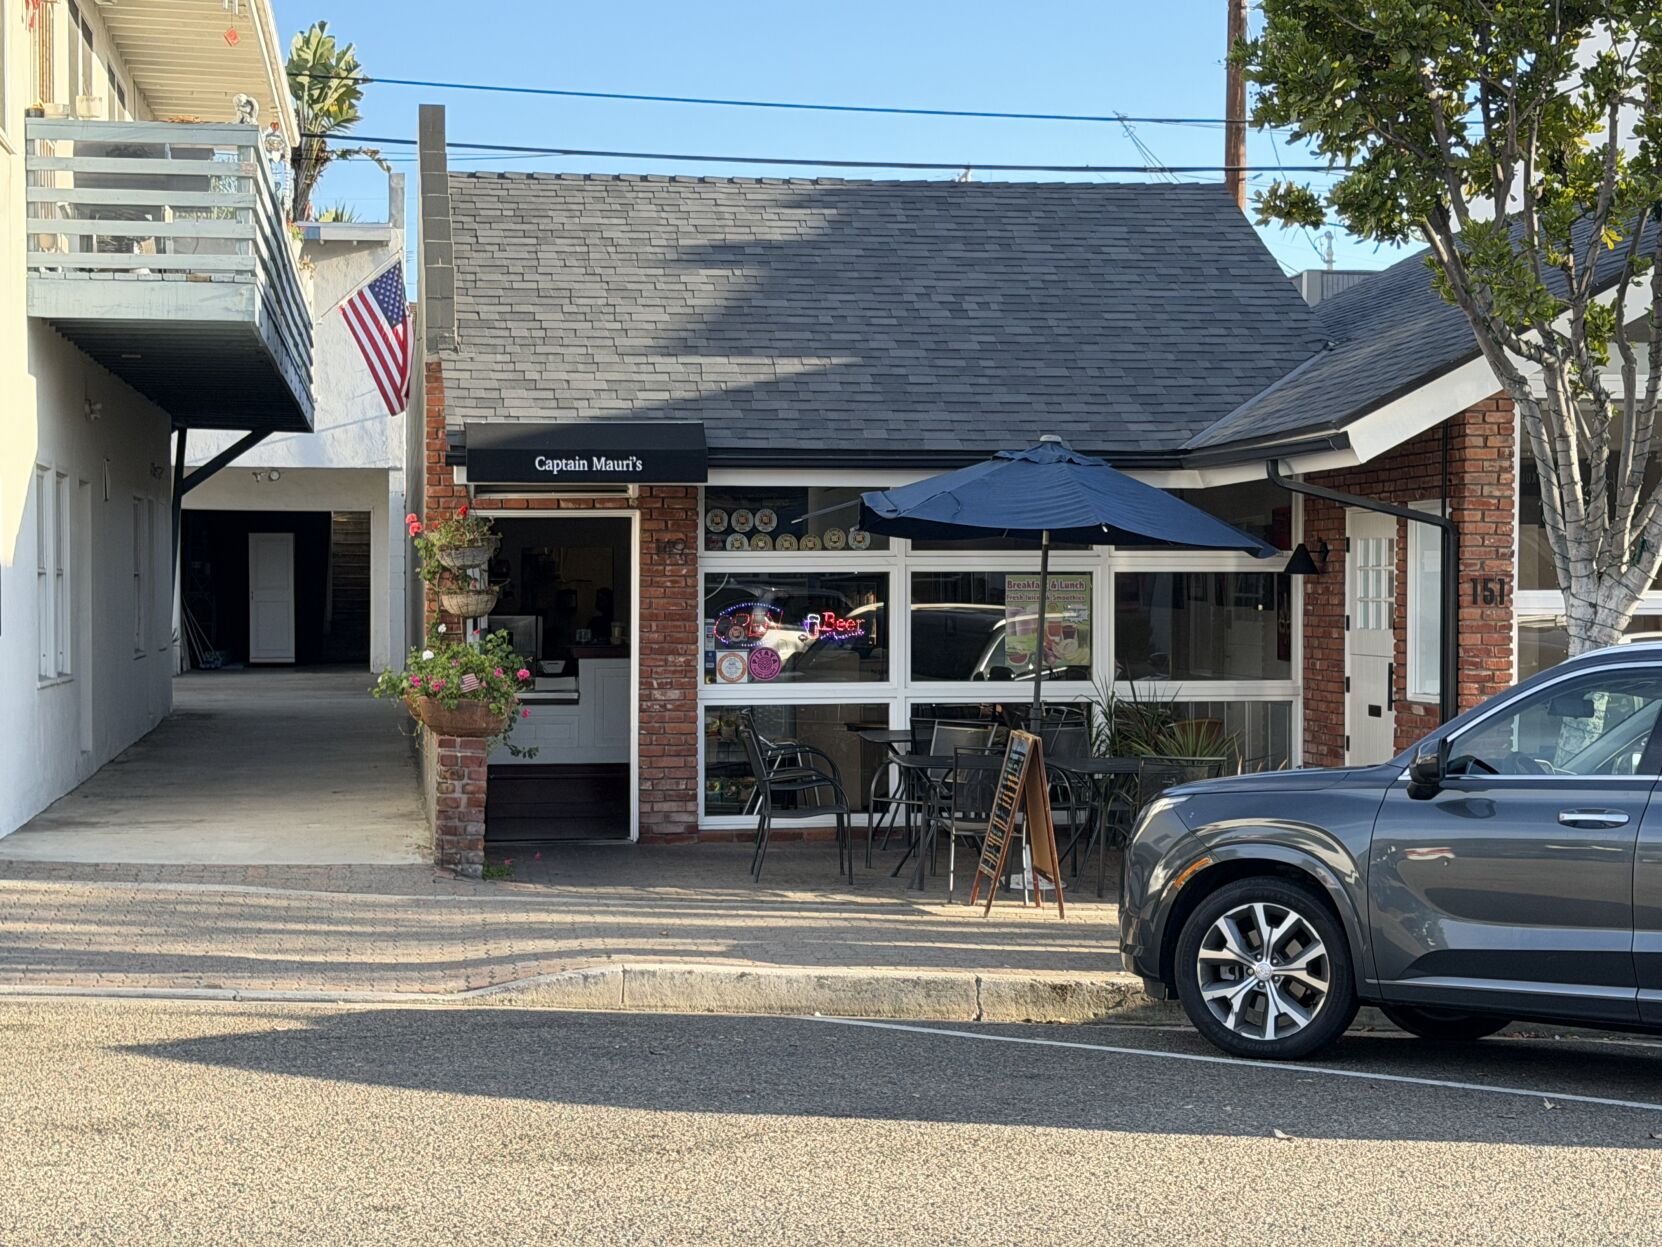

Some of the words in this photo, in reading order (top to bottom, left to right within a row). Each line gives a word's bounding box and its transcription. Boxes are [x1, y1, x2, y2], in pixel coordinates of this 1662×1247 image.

[535, 455, 588, 475] Captain
[592, 455, 643, 471] Mauri's
[1007, 580, 1047, 589] Breakfa
[1060, 581, 1084, 589] Lunch
[1471, 577, 1505, 605] 151
[820, 611, 865, 632] Beer
[751, 650, 778, 665] PITAYA
